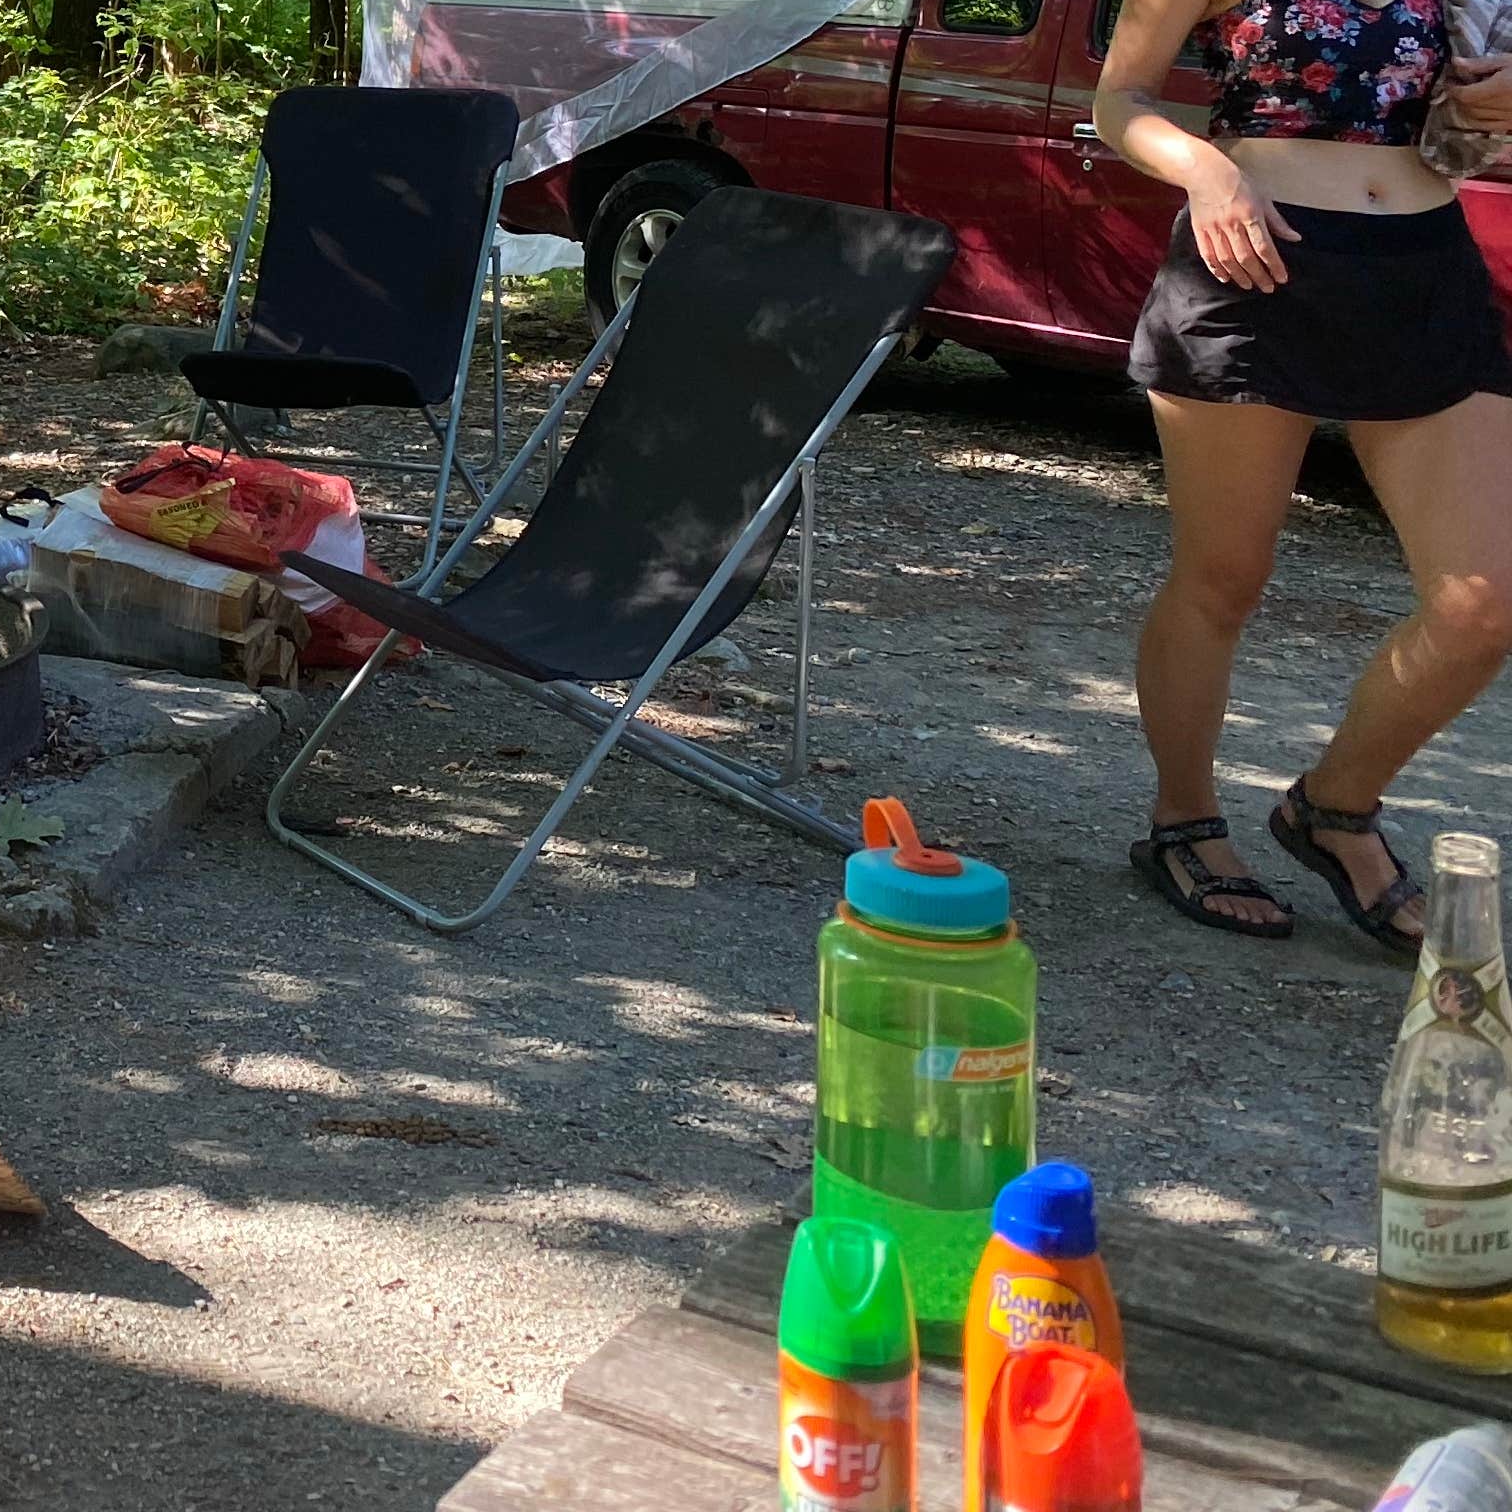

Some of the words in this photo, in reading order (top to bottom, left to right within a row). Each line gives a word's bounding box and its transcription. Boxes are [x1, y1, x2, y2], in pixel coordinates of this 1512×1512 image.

[157, 500, 200, 517] EASONED
[958, 1048, 1030, 1076] nalgen
[1387, 1222, 1448, 1256] HIGH
[1452, 1229, 1511, 1256] LIFE
[996, 1275, 1089, 1321] BANANA
[1007, 1313, 1074, 1346] BOAT
[784, 1422, 882, 1491] OFF!
